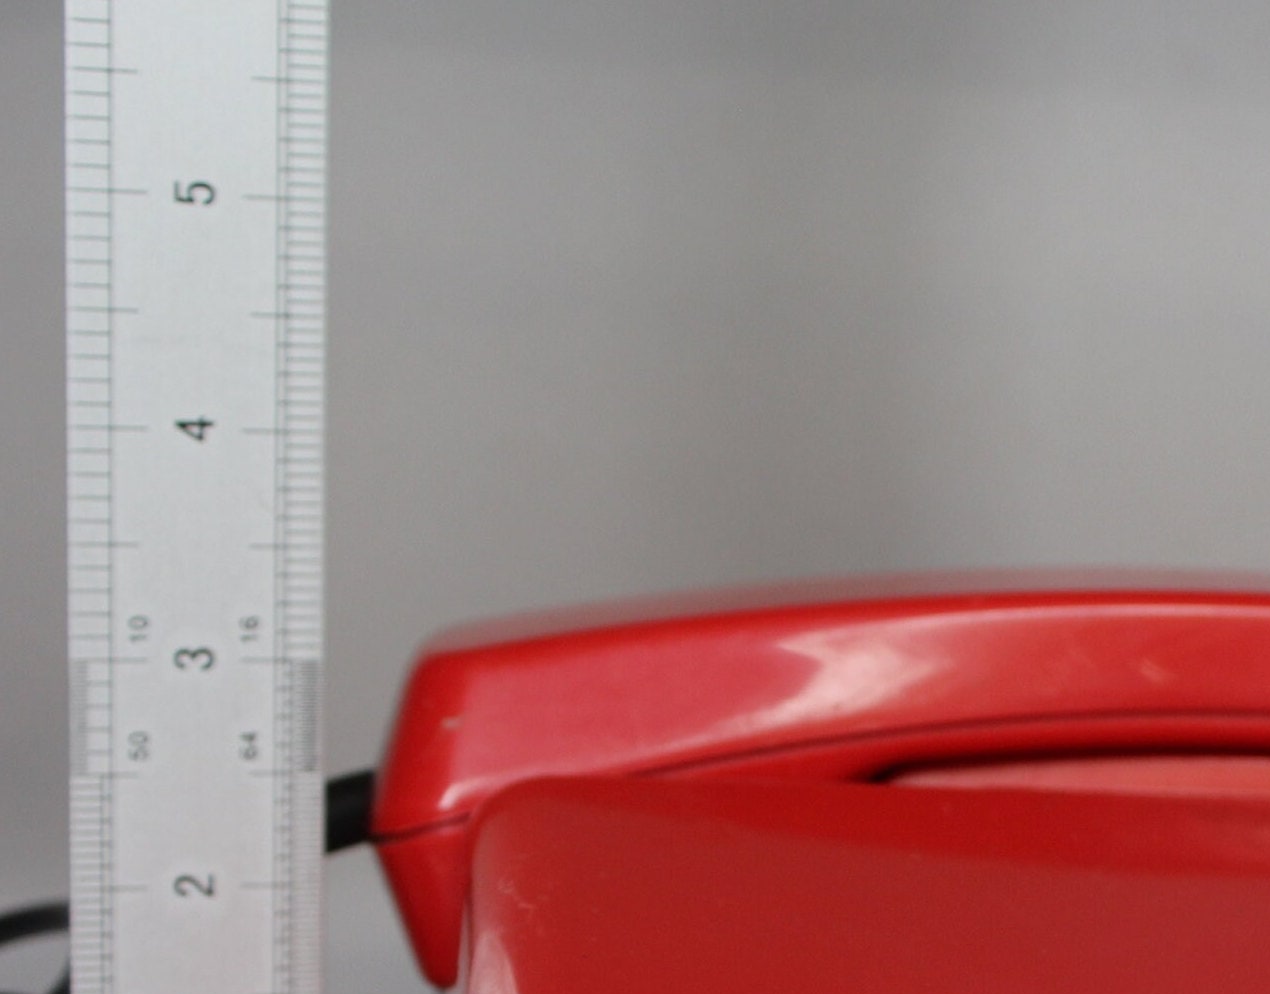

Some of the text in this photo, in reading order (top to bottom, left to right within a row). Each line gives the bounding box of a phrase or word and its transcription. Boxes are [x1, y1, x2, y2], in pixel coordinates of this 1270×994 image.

[173, 180, 217, 206] 5
[174, 416, 216, 442] 4
[128, 615, 150, 643] 10
[239, 615, 260, 643] 16
[173, 647, 216, 671] 3
[127, 730, 151, 762] 50
[240, 731, 260, 761] 64
[173, 874, 216, 898] 2
